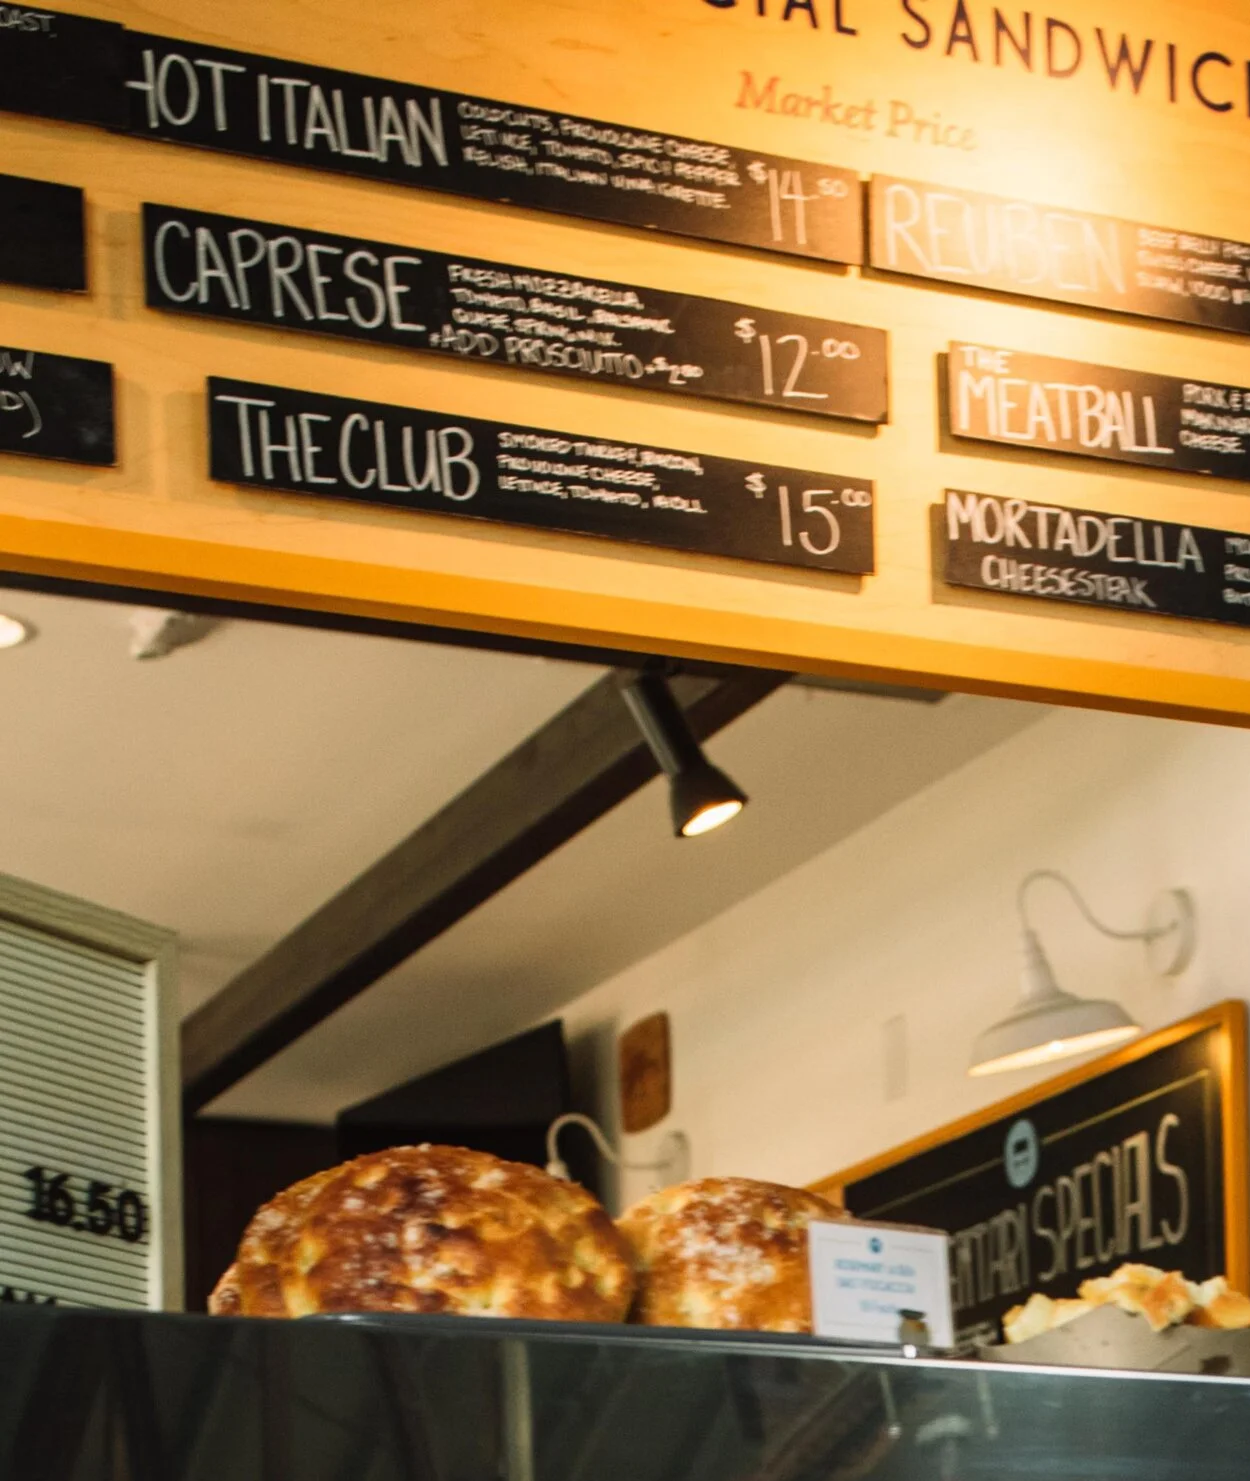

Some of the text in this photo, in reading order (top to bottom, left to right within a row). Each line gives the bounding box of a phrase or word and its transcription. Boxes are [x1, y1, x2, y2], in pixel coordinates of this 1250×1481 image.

[258, 74, 448, 166] ITALIAN
[735, 69, 978, 152] Market Price
[154, 221, 425, 331] CAPRESE
[885, 183, 1128, 294] REUBEN
[960, 344, 1014, 374] THE
[215, 394, 481, 501] THE CLUB
[958, 369, 1175, 454] MEATBALL
[946, 491, 1205, 575] MORTADELLA
[23, 1166, 146, 1242] 16.50
[1030, 1112, 1189, 1284] SPECIALS
